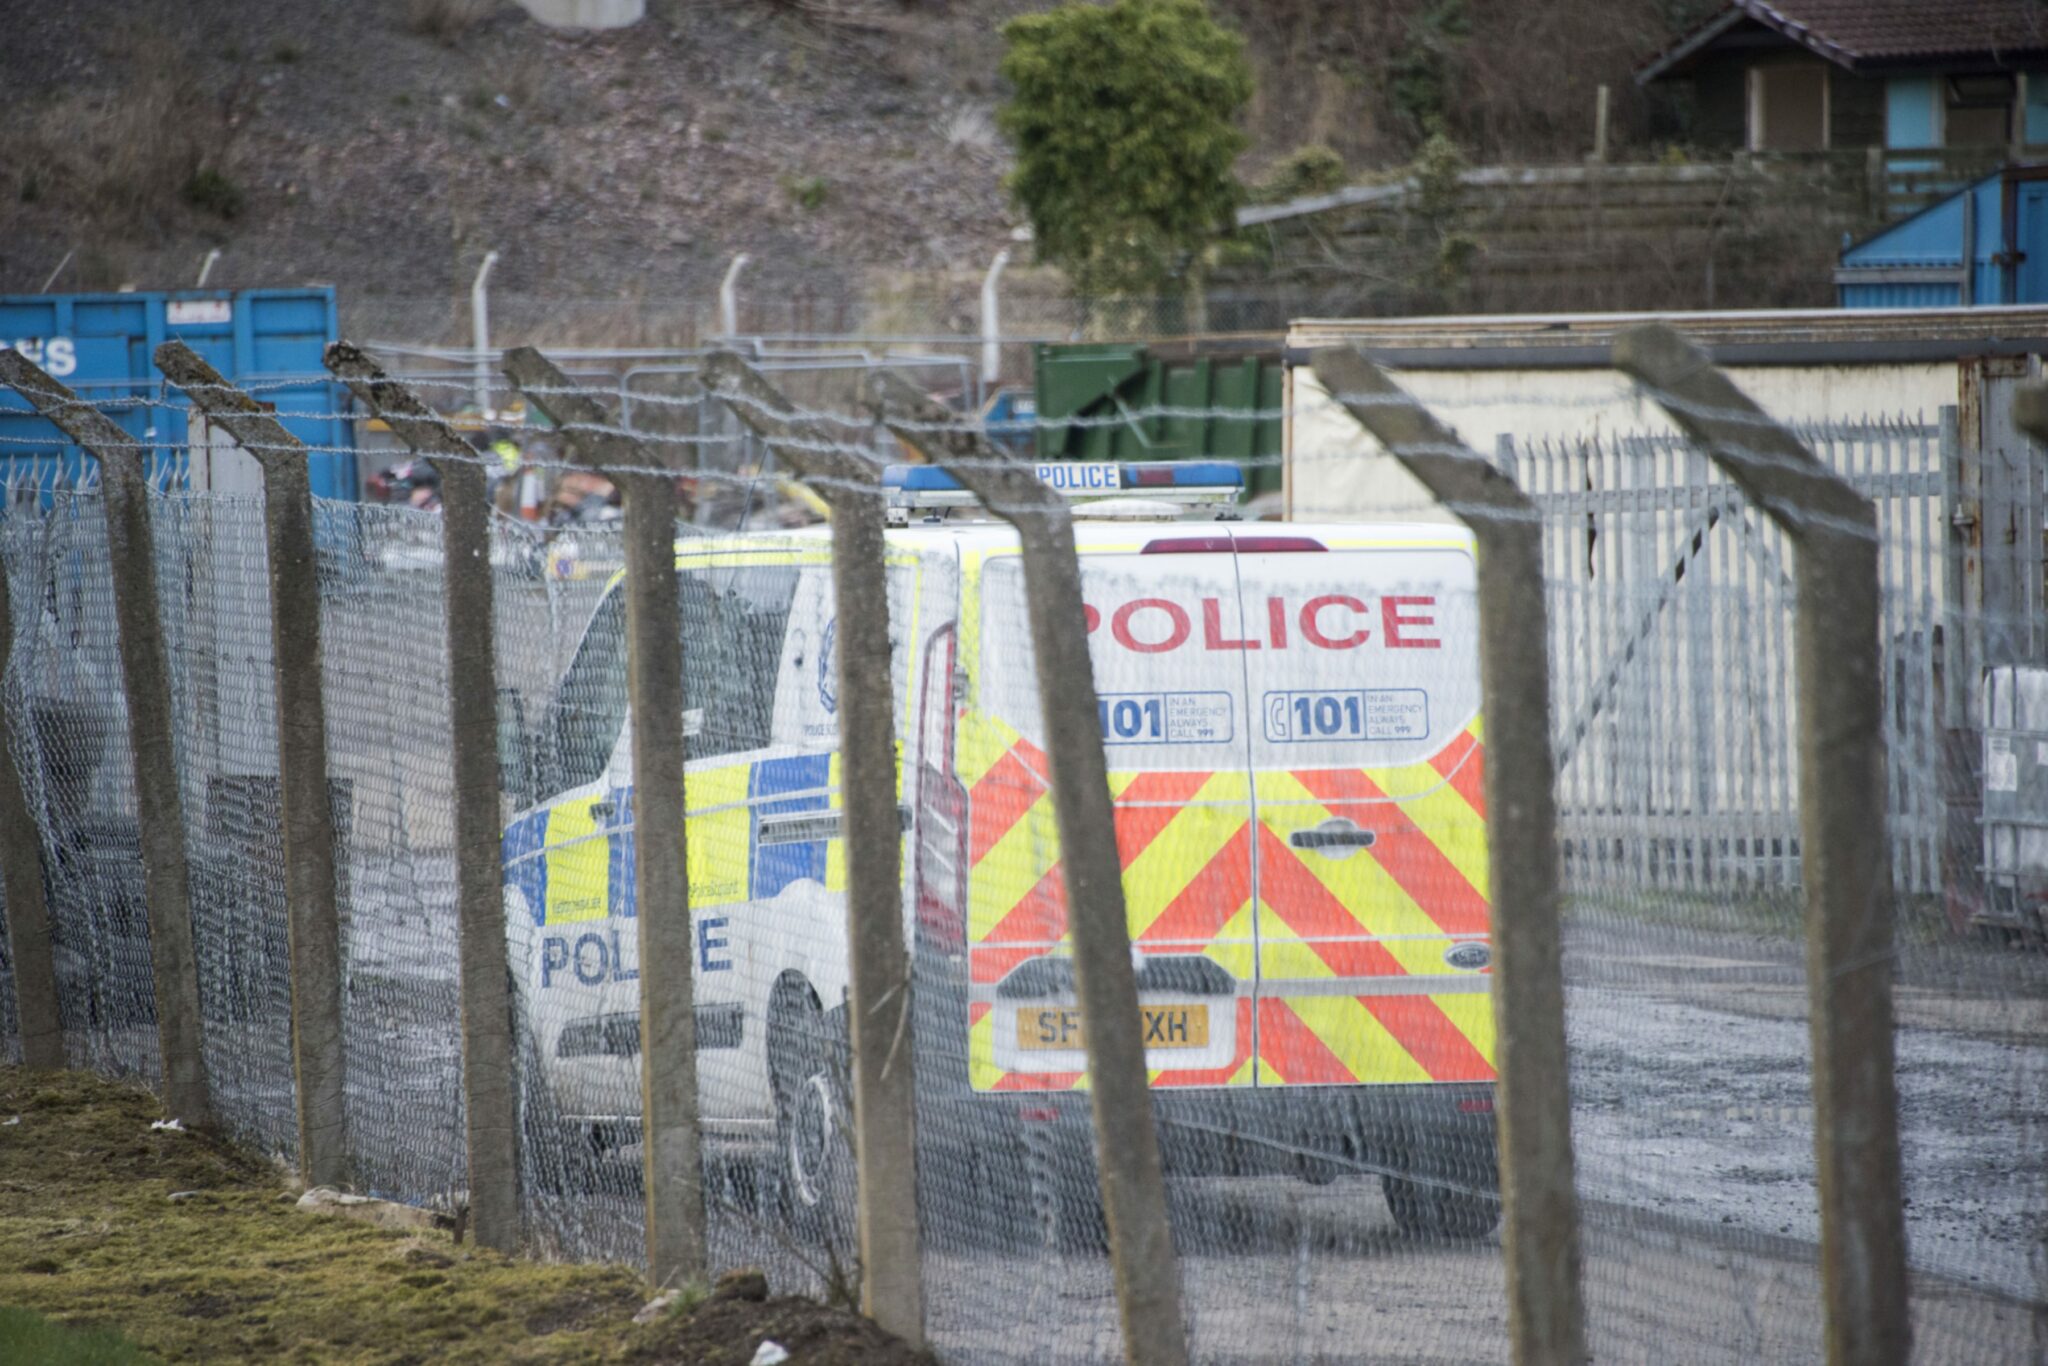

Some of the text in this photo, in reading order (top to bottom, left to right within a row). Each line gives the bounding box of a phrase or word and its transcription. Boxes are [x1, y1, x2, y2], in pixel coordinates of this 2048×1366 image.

[0, 336, 77, 376] ES
[1038, 465, 1117, 489] POLICE
[1294, 696, 1361, 735] 101
[542, 917, 733, 988] POLE
[1038, 1011, 1187, 1042] SF XH
